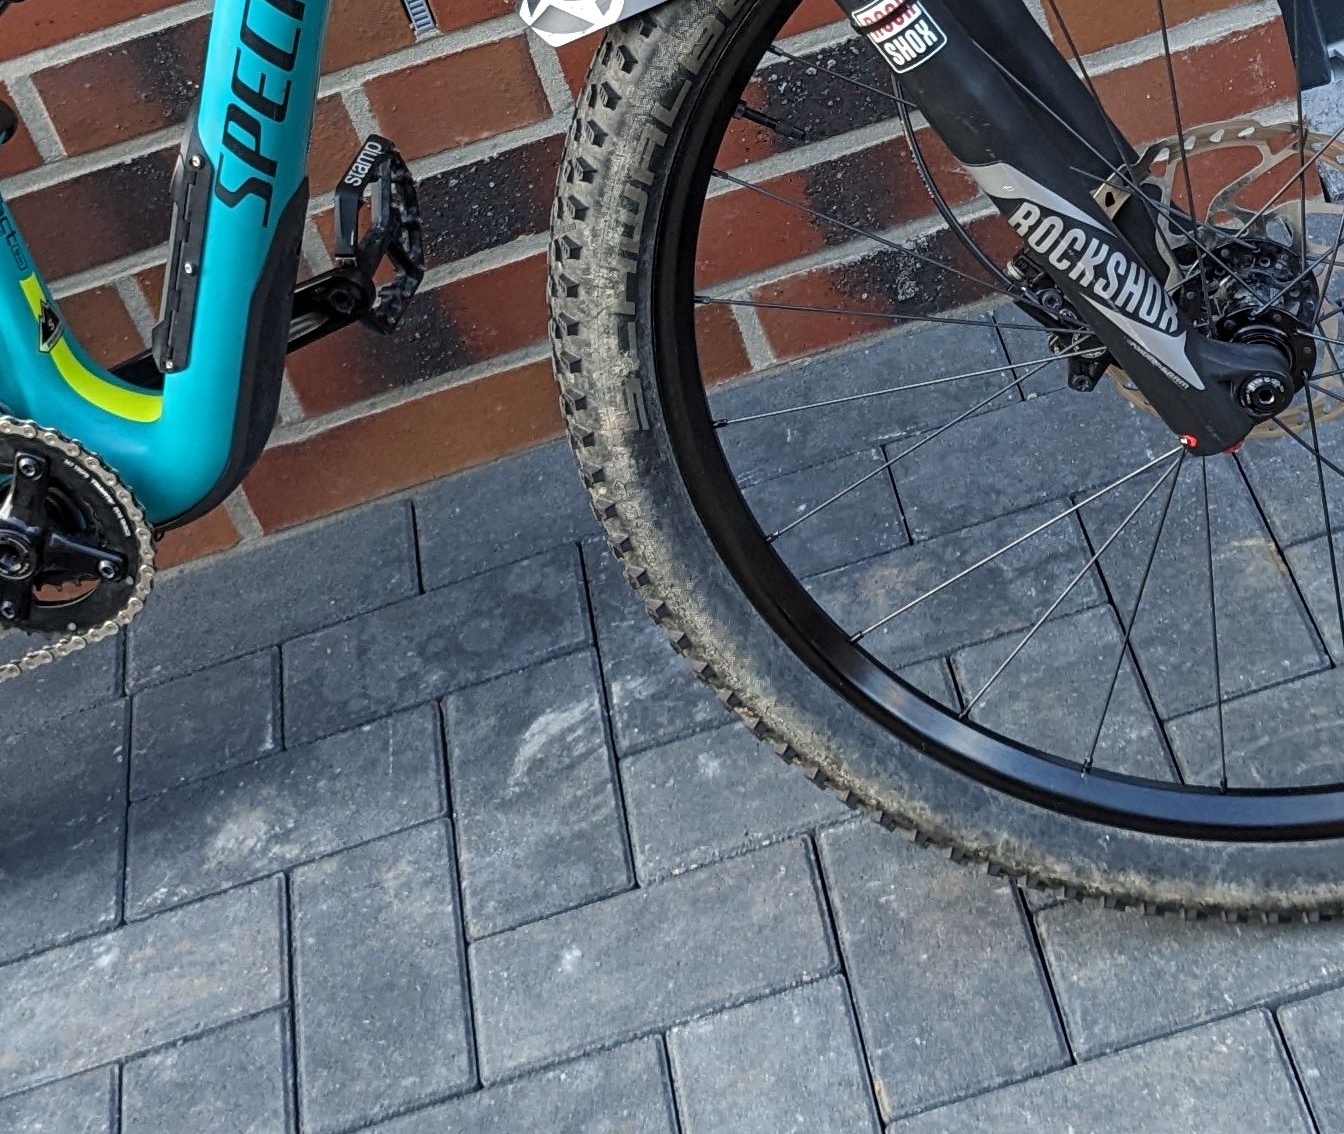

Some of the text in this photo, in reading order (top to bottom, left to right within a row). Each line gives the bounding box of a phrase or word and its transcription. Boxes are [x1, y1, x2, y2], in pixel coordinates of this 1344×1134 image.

[883, 18, 939, 66] SHOX
[344, 141, 384, 187] stamp
[1007, 201, 1179, 333] ROCKSHOX
